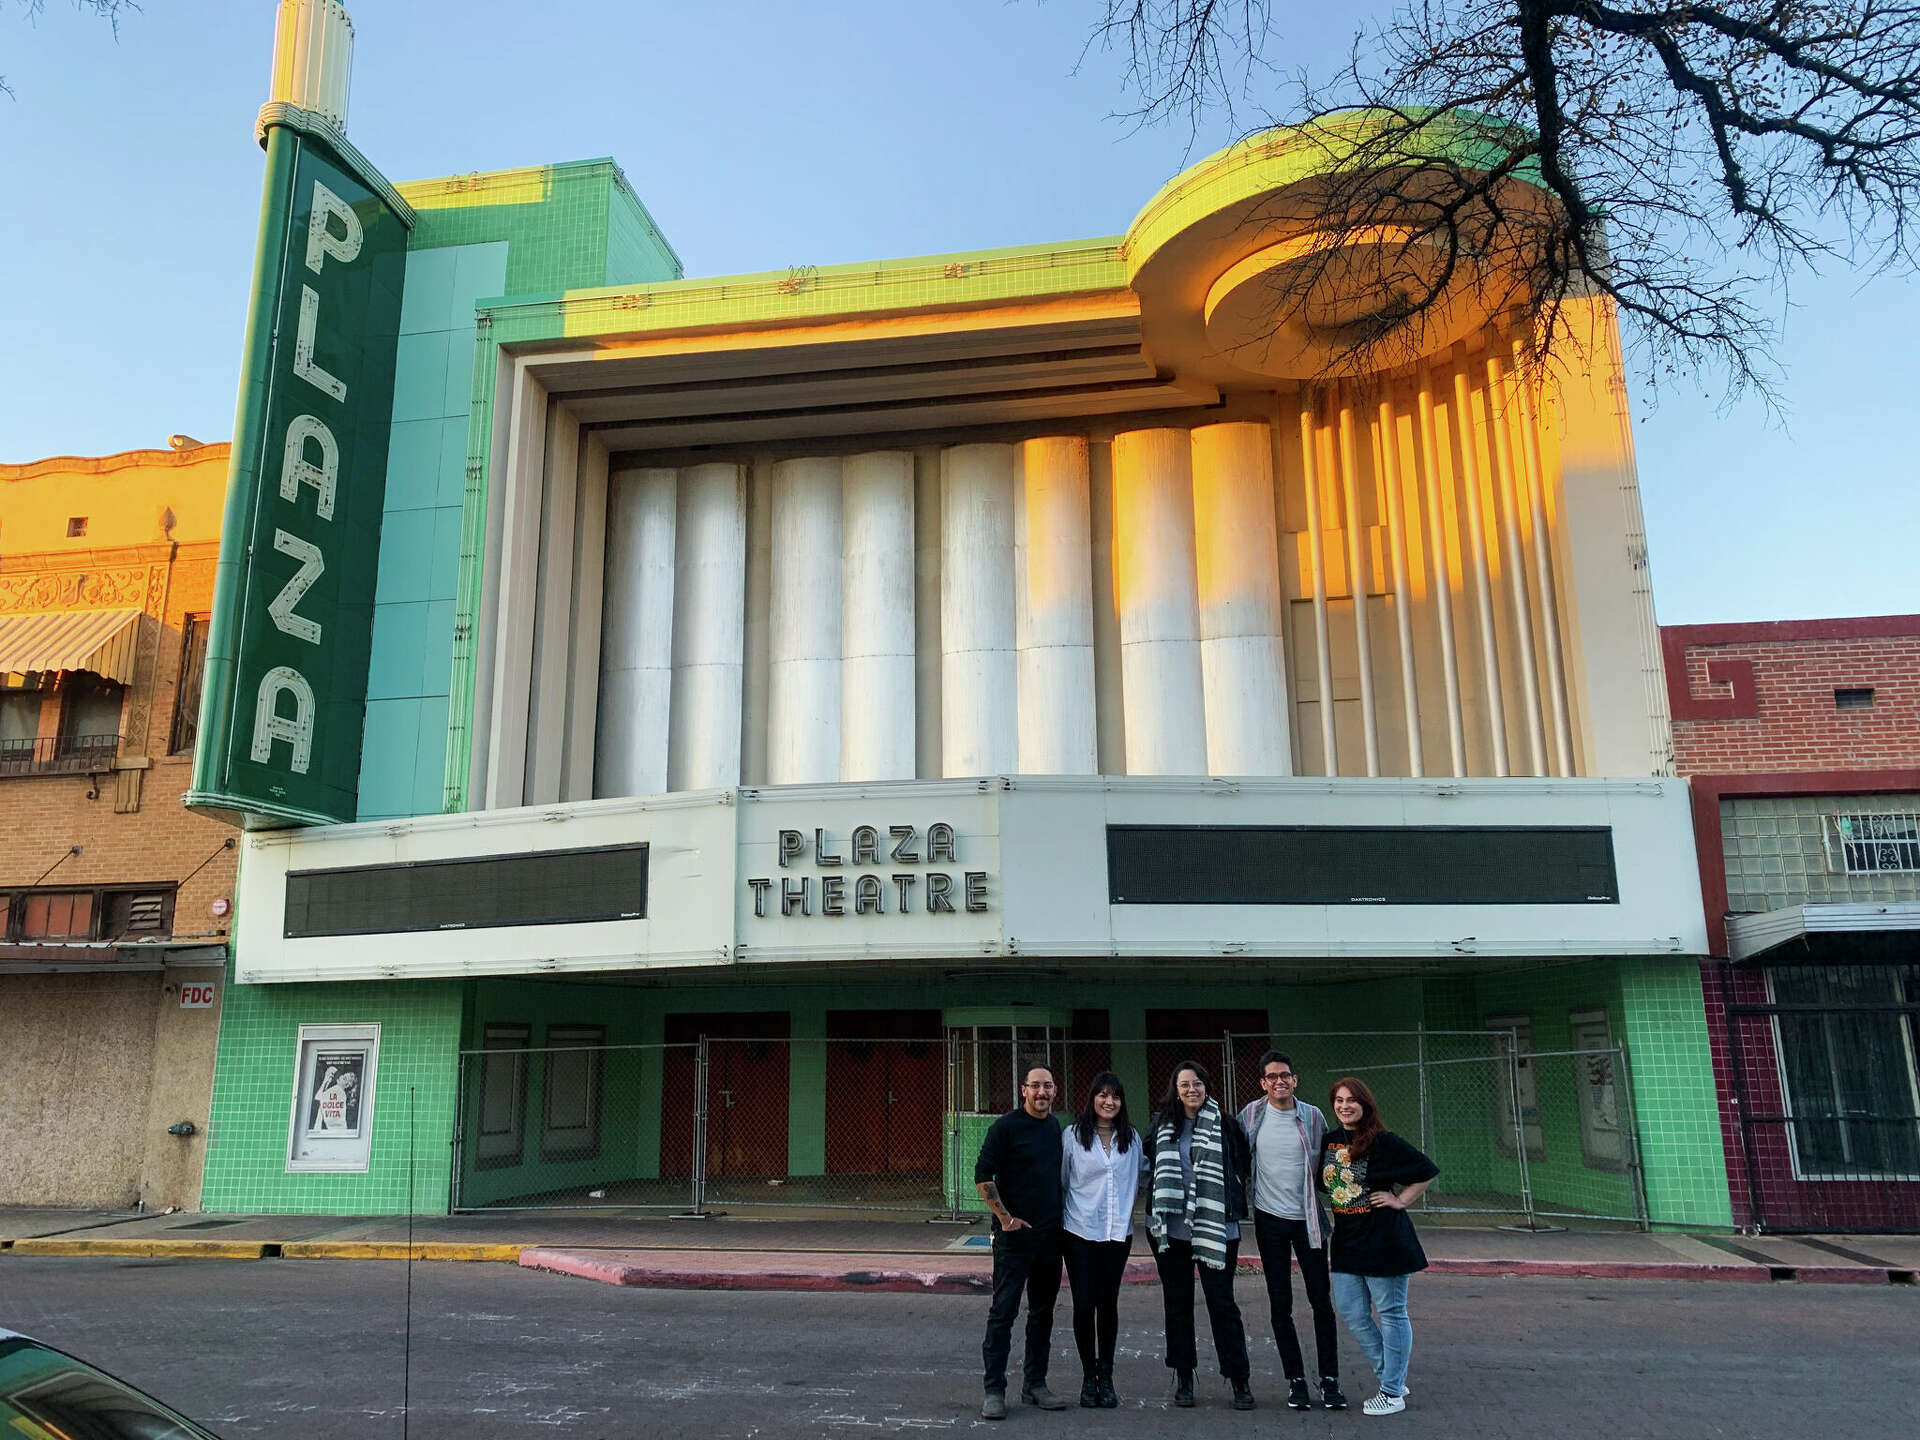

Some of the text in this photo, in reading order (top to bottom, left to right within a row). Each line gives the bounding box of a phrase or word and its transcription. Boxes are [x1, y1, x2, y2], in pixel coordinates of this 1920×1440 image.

[249, 179, 363, 775] PLAZA
[778, 822, 957, 868] PLAZA
[747, 871, 988, 917] THEATRE
[181, 986, 213, 1004] FDC
[322, 1101, 345, 1109] DOLCE
[329, 1093, 338, 1101] LA
[325, 1110, 341, 1118] VITA
